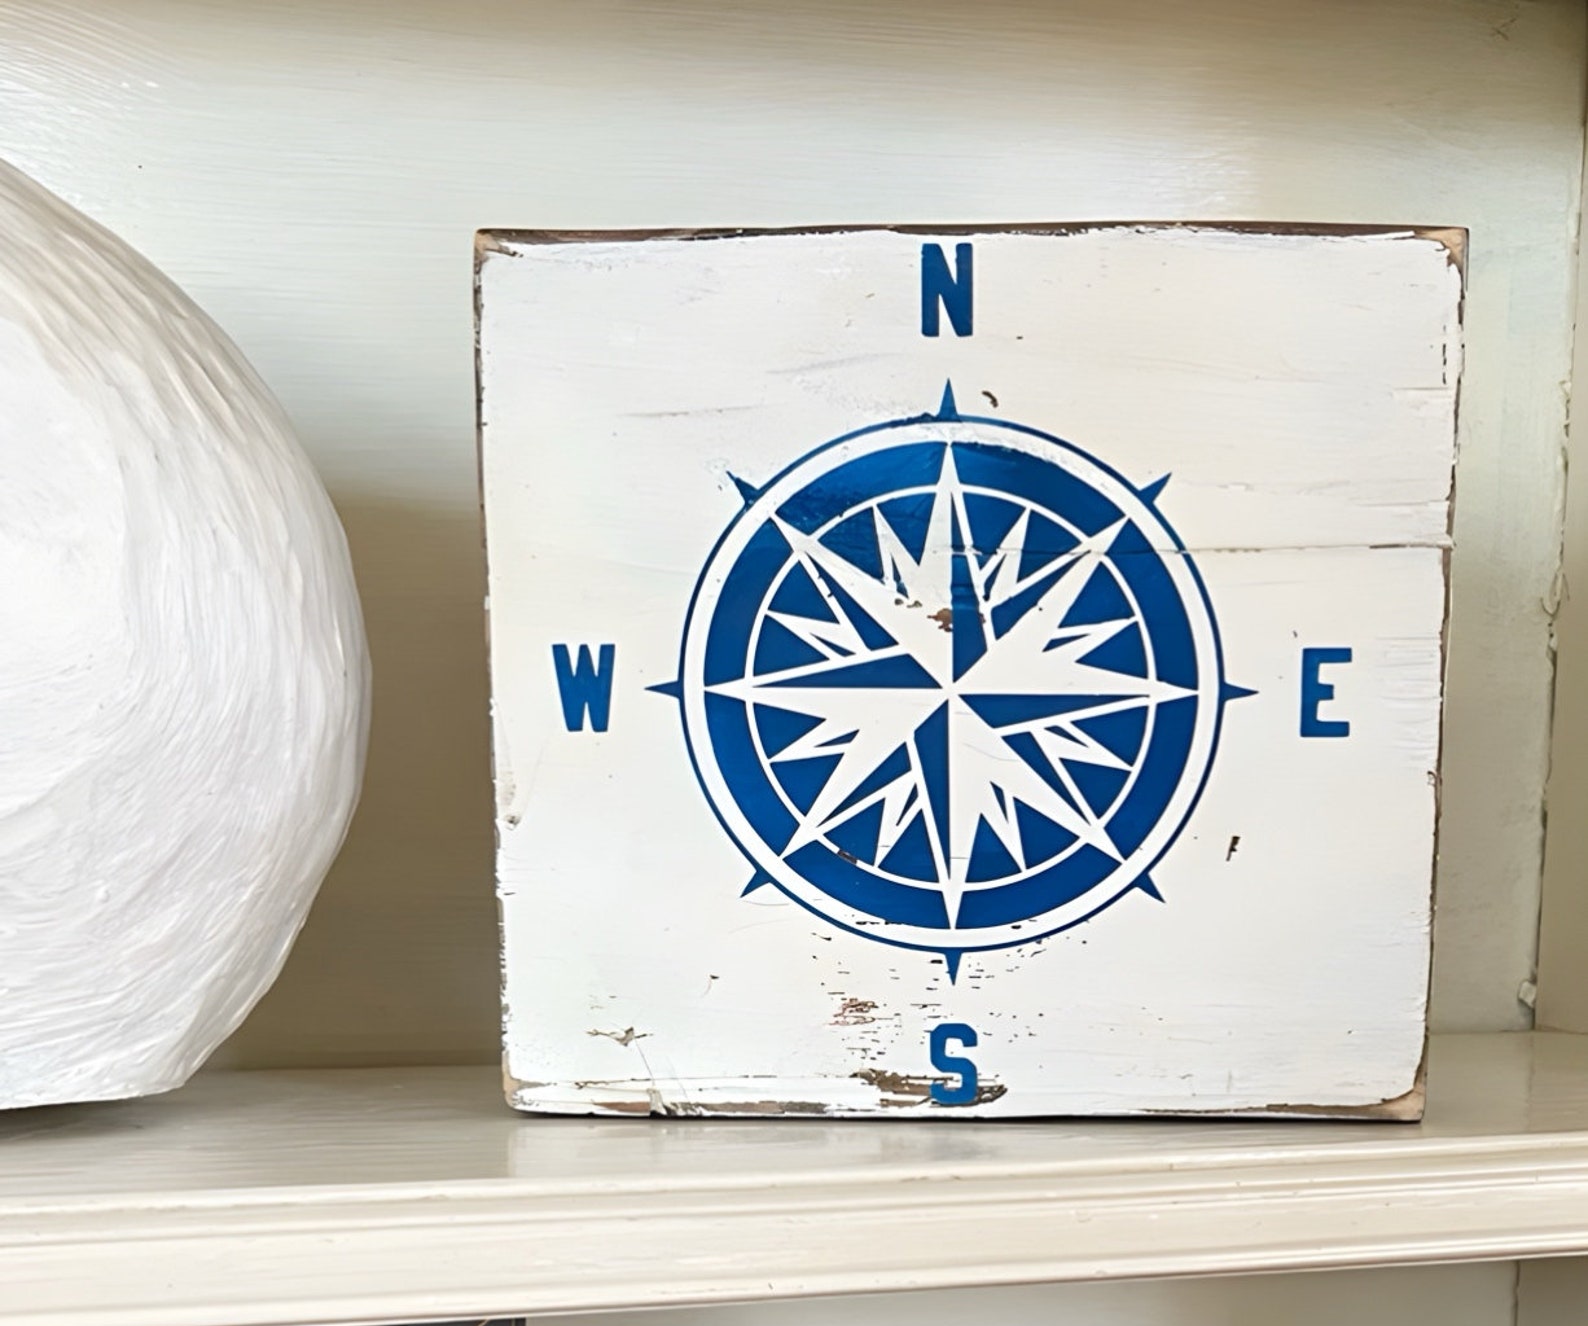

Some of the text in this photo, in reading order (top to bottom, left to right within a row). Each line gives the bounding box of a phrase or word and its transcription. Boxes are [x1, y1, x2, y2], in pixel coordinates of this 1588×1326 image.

[920, 242, 972, 337] N
[552, 643, 615, 733] W
[1300, 647, 1353, 737] E
[929, 1022, 978, 1105] S
